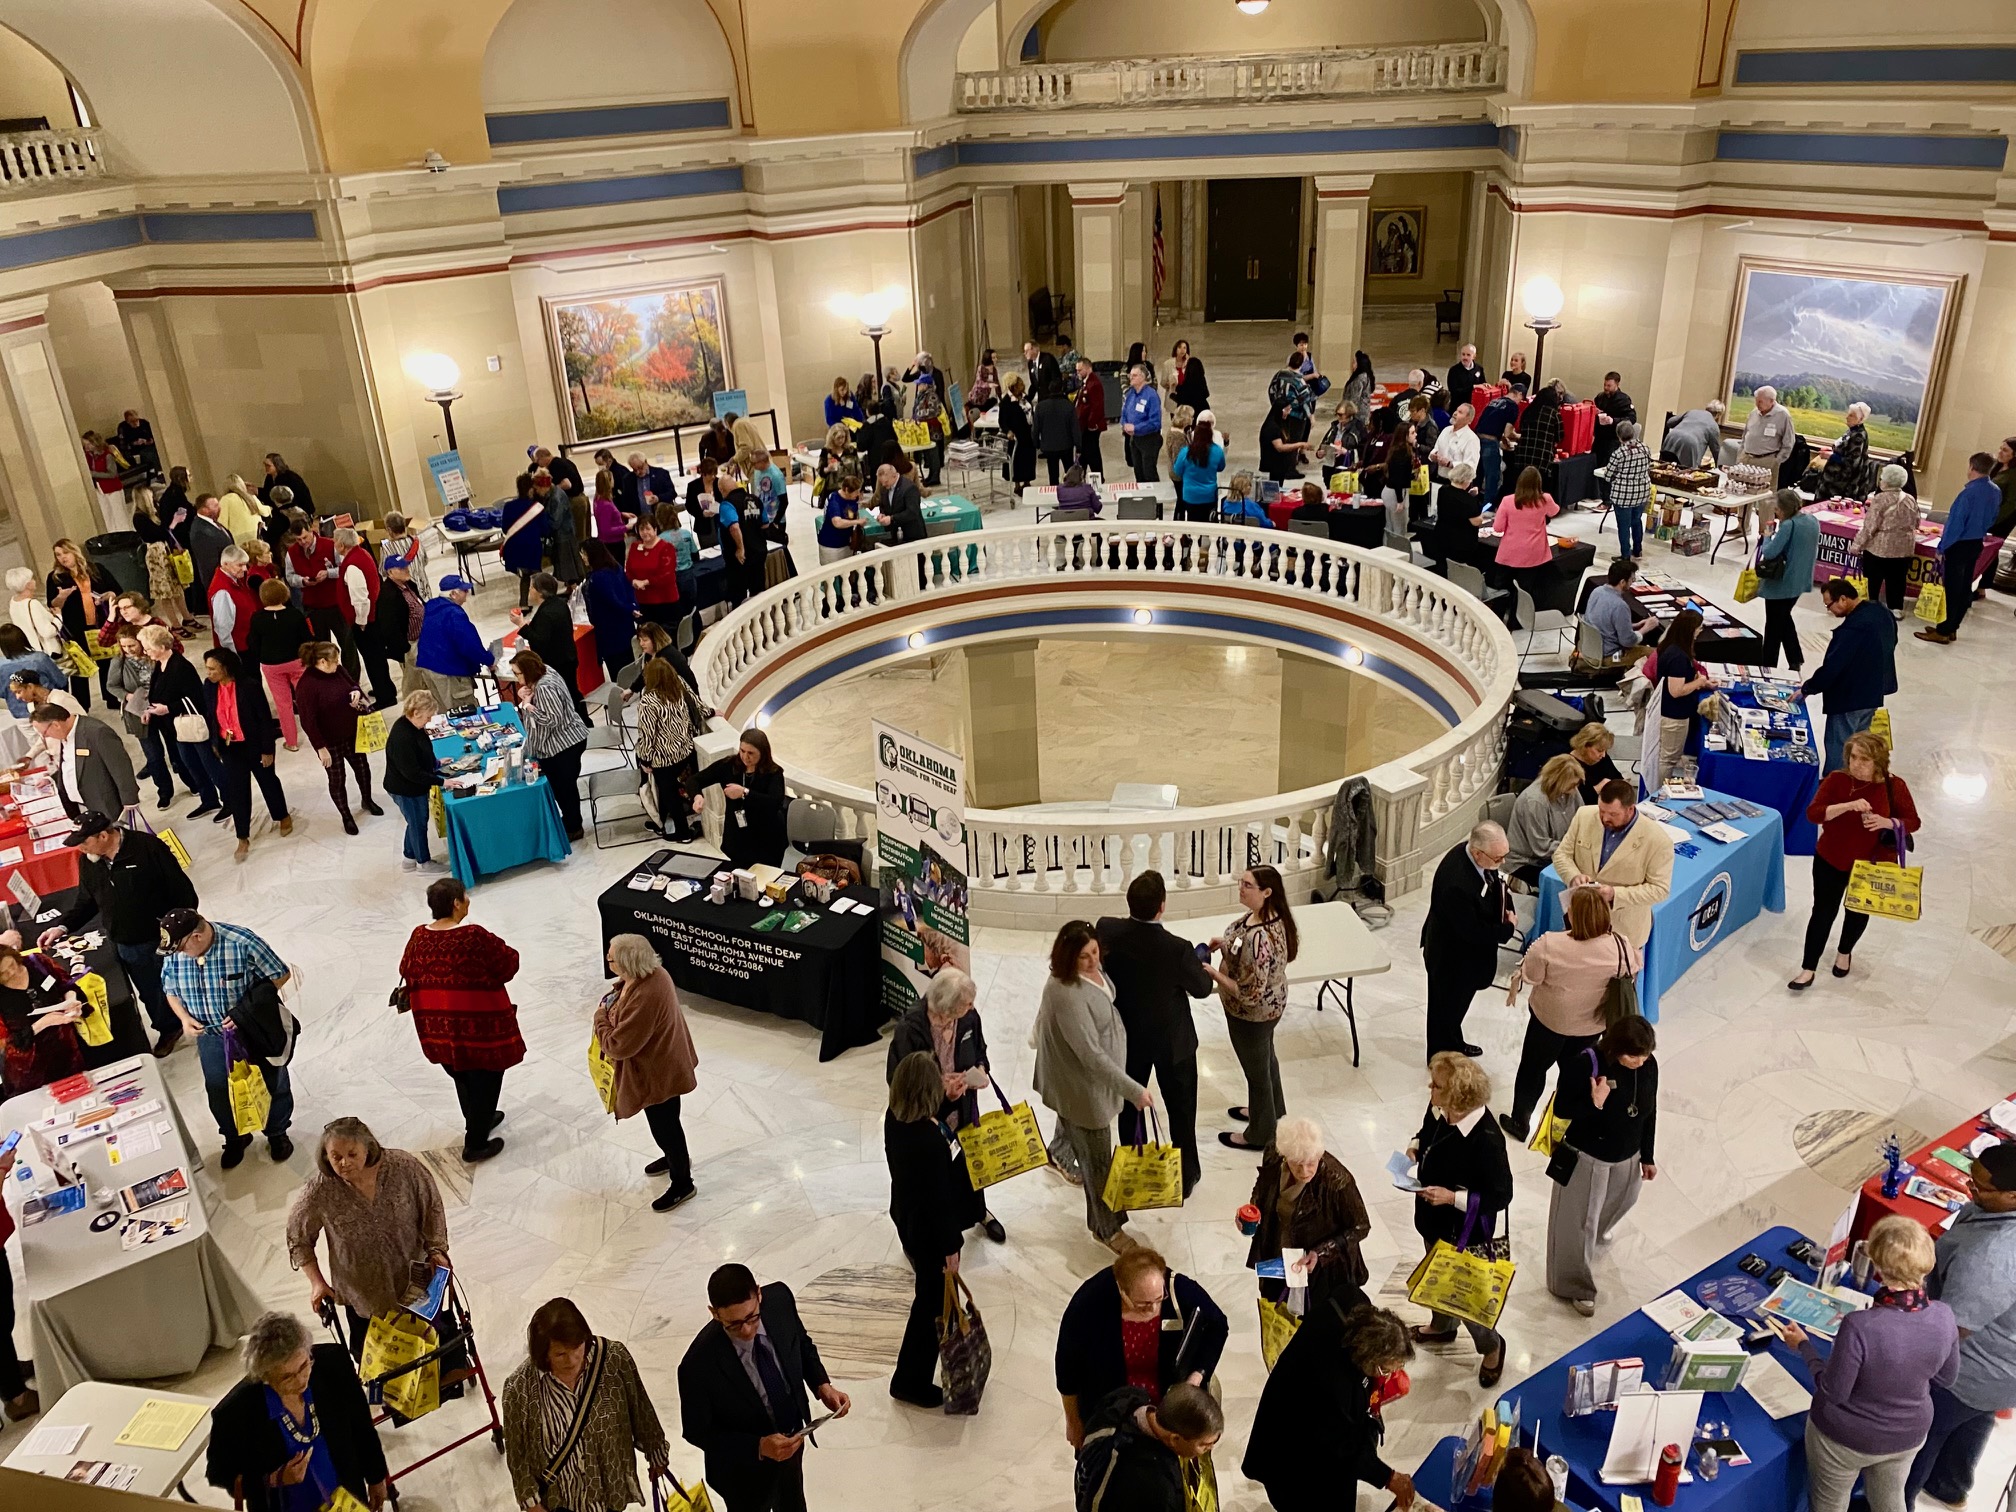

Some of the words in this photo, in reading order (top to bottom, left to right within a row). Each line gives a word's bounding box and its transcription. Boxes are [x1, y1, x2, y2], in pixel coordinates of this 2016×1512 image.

[1818, 533, 1845, 550] OMA'S
[900, 745, 957, 783] OKLAHOMA
[900, 763, 919, 778] SCHOOL
[920, 773, 931, 783] FOR
[931, 777, 942, 789] THE
[943, 784, 957, 795] DEAF
[880, 834, 909, 852] EQUIPMENT
[881, 843, 914, 864] DISTRIBUTION
[881, 851, 906, 867] PROGRAM
[1870, 881, 1896, 892] TULSA
[930, 912, 954, 928] HEARING
[955, 924, 964, 934] AID
[933, 905, 964, 925] CHILDREN'S
[633, 910, 686, 931] OKLAHOMA
[688, 925, 729, 944] SCHOOL
[731, 937, 752, 950] FOR
[753, 942, 773, 954] THE
[775, 947, 802, 961] DEAF
[882, 920, 900, 934] SENIOR
[900, 930, 922, 947] CITIZENS
[883, 929, 904, 945] HEARING
[905, 941, 914, 949] AID
[938, 923, 965, 942] PROGRAM
[652, 925, 669, 937] 1100
[671, 930, 694, 944] EAST
[695, 939, 746, 959] OKLAHOMA
[748, 952, 785, 968] AVENUE
[883, 937, 908, 954] PROGRAM
[722, 955, 736, 966] OK
[737, 959, 764, 973] 73086
[882, 975, 905, 994] Contact
